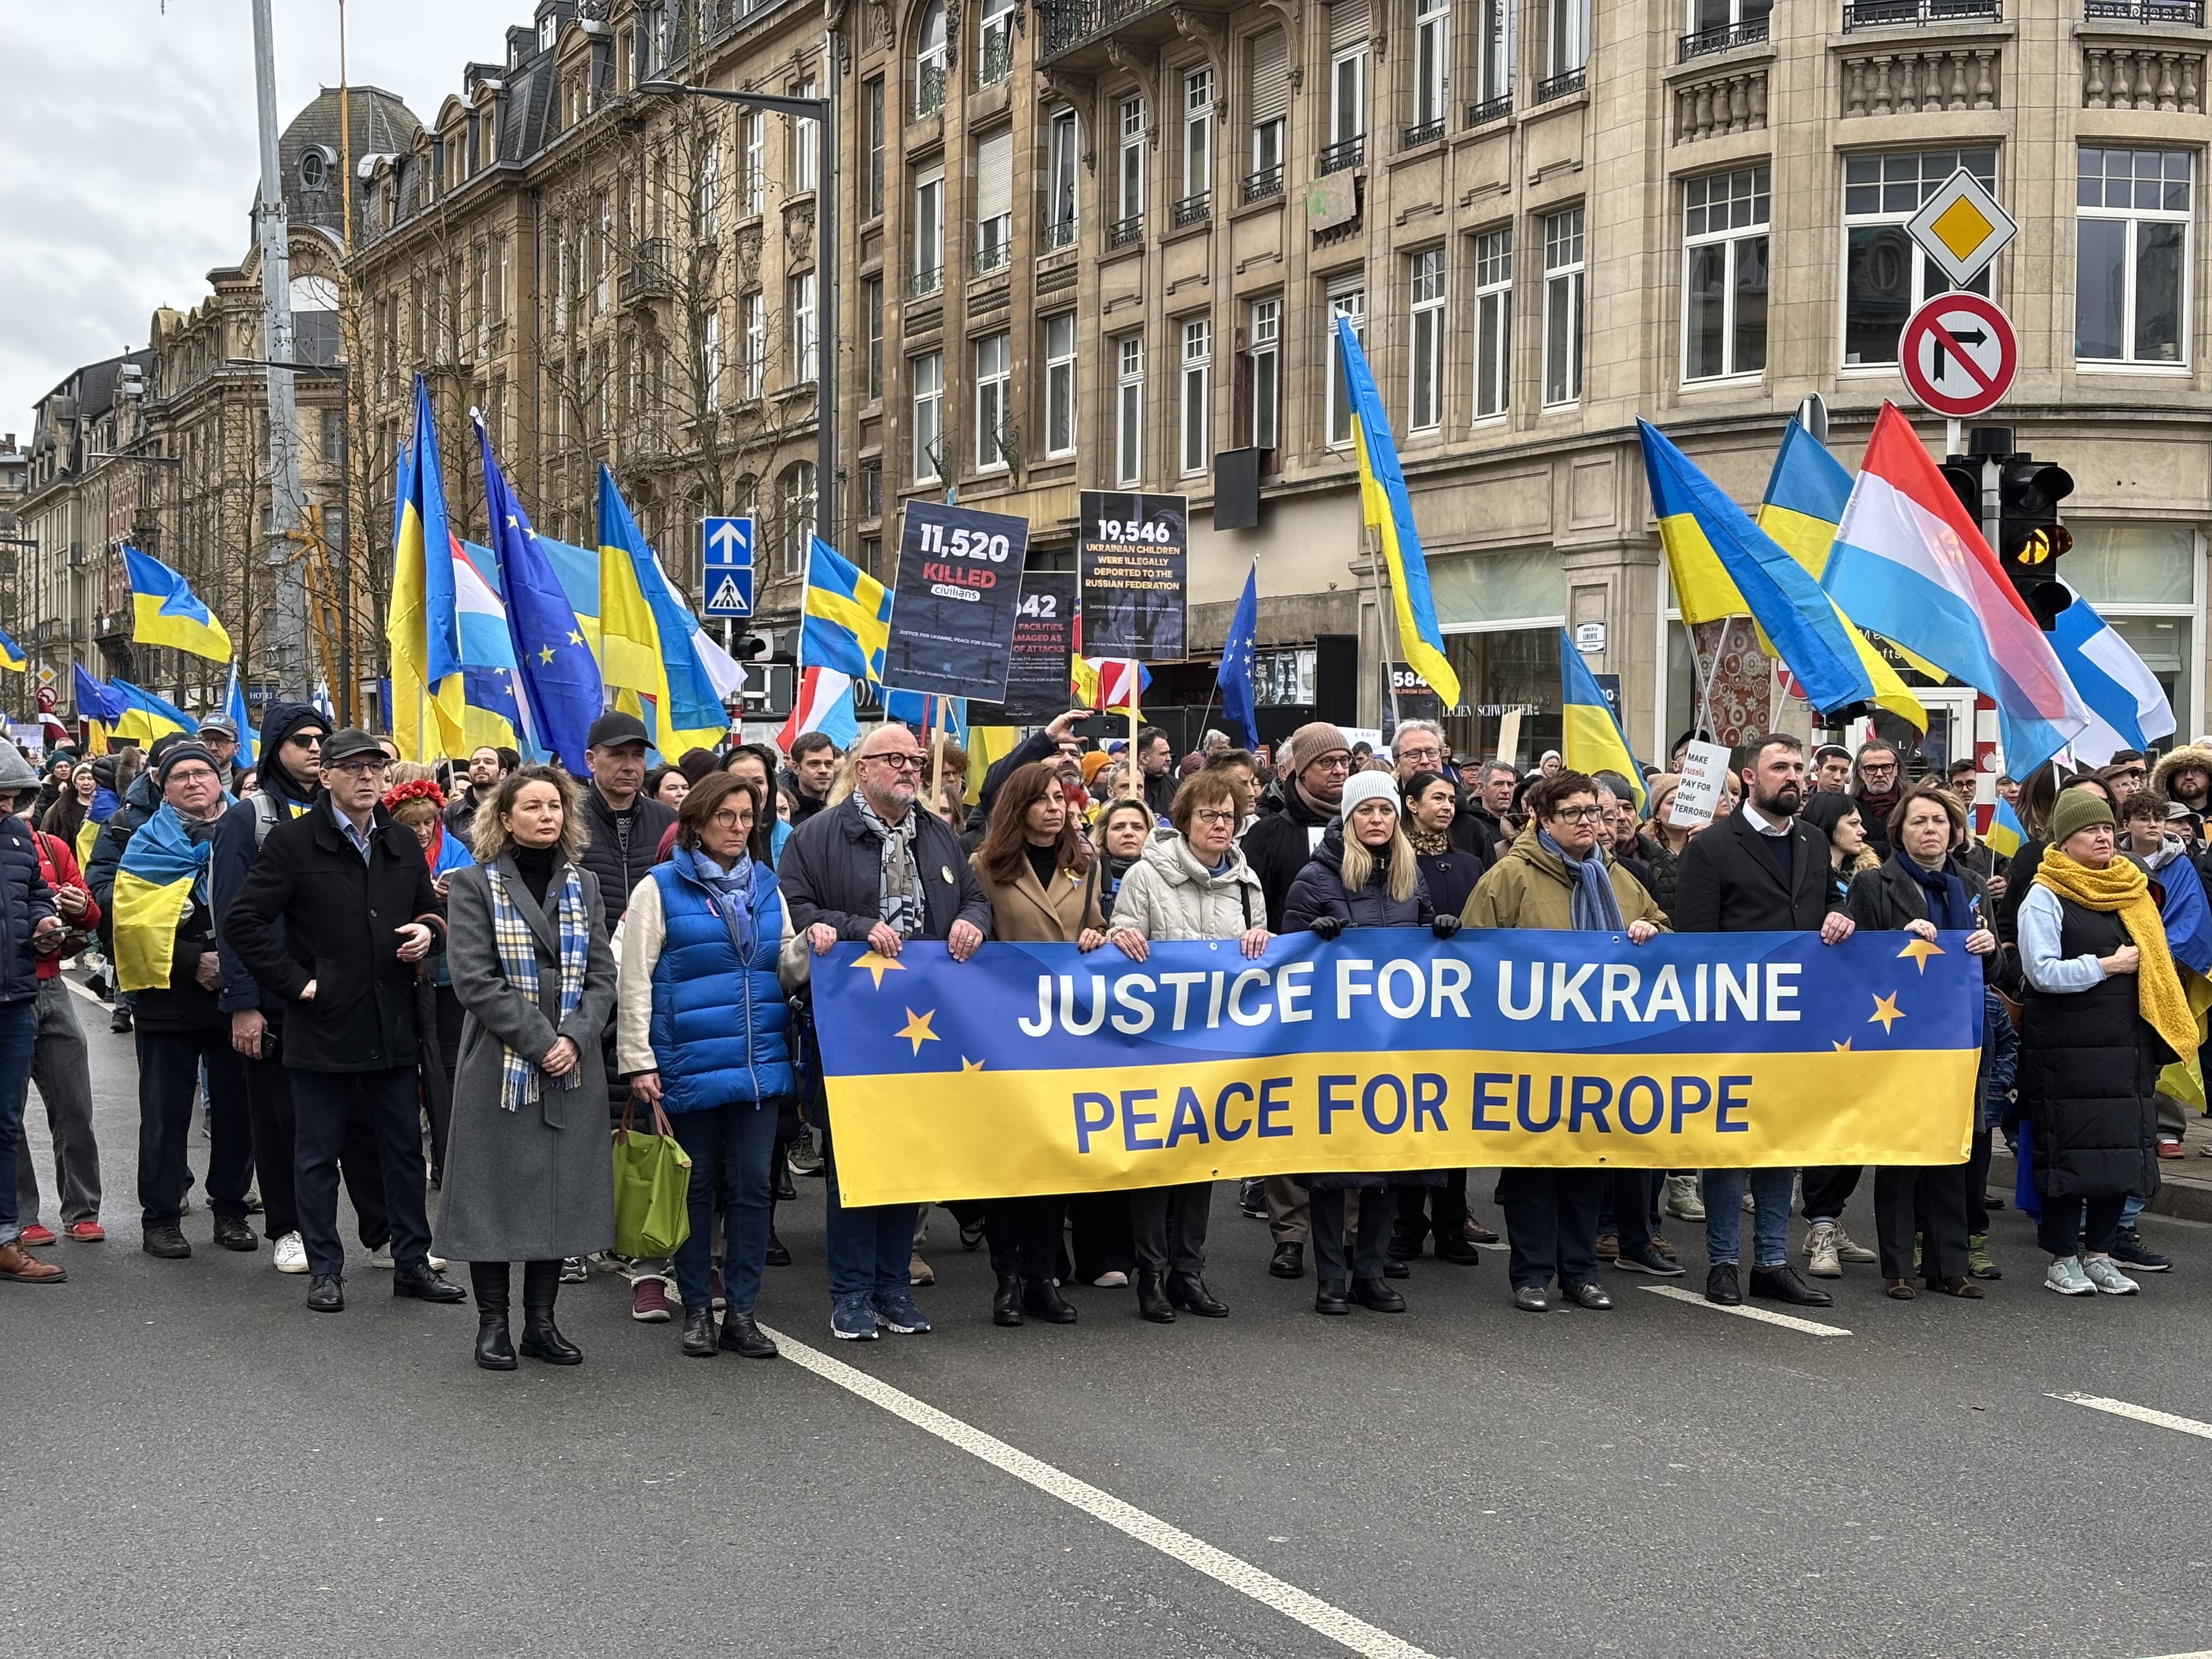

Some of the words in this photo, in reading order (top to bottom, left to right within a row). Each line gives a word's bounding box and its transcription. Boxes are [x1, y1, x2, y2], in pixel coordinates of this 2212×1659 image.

[1098, 520, 1170, 544] 19,546
[921, 523, 1009, 562] 11,520
[1086, 543, 1135, 554] UKRAINIAN
[1136, 545, 1180, 555] CHILDREN
[1097, 555, 1123, 565] WERE
[1125, 556, 1169, 566] ILLEGALLY
[922, 562, 996, 589] KILLED
[1093, 567, 1141, 577] DEPORTED
[1142, 569, 1155, 578] TO
[1155, 569, 1173, 578] THE
[1085, 578, 1124, 588] RUSSIAN
[1125, 580, 1180, 590] FEDERATION
[934, 585, 978, 601] civilians
[1393, 671, 1427, 687] 584
[1687, 752, 1709, 765] MAKE
[1684, 767, 1705, 777] russia
[1680, 778, 1697, 789] PAY
[1697, 782, 1711, 792] FOR
[1678, 791, 1696, 802] their
[1674, 803, 1713, 819] TERRORISM
[1018, 962, 1313, 1037] JUSTICE
[1336, 959, 1471, 1020] FOR
[1497, 961, 1802, 1022] UKRAINE
[1072, 1076, 1294, 1155] PEACE
[1317, 1071, 1449, 1136] FOR
[1471, 1071, 1753, 1134] EUROPE
